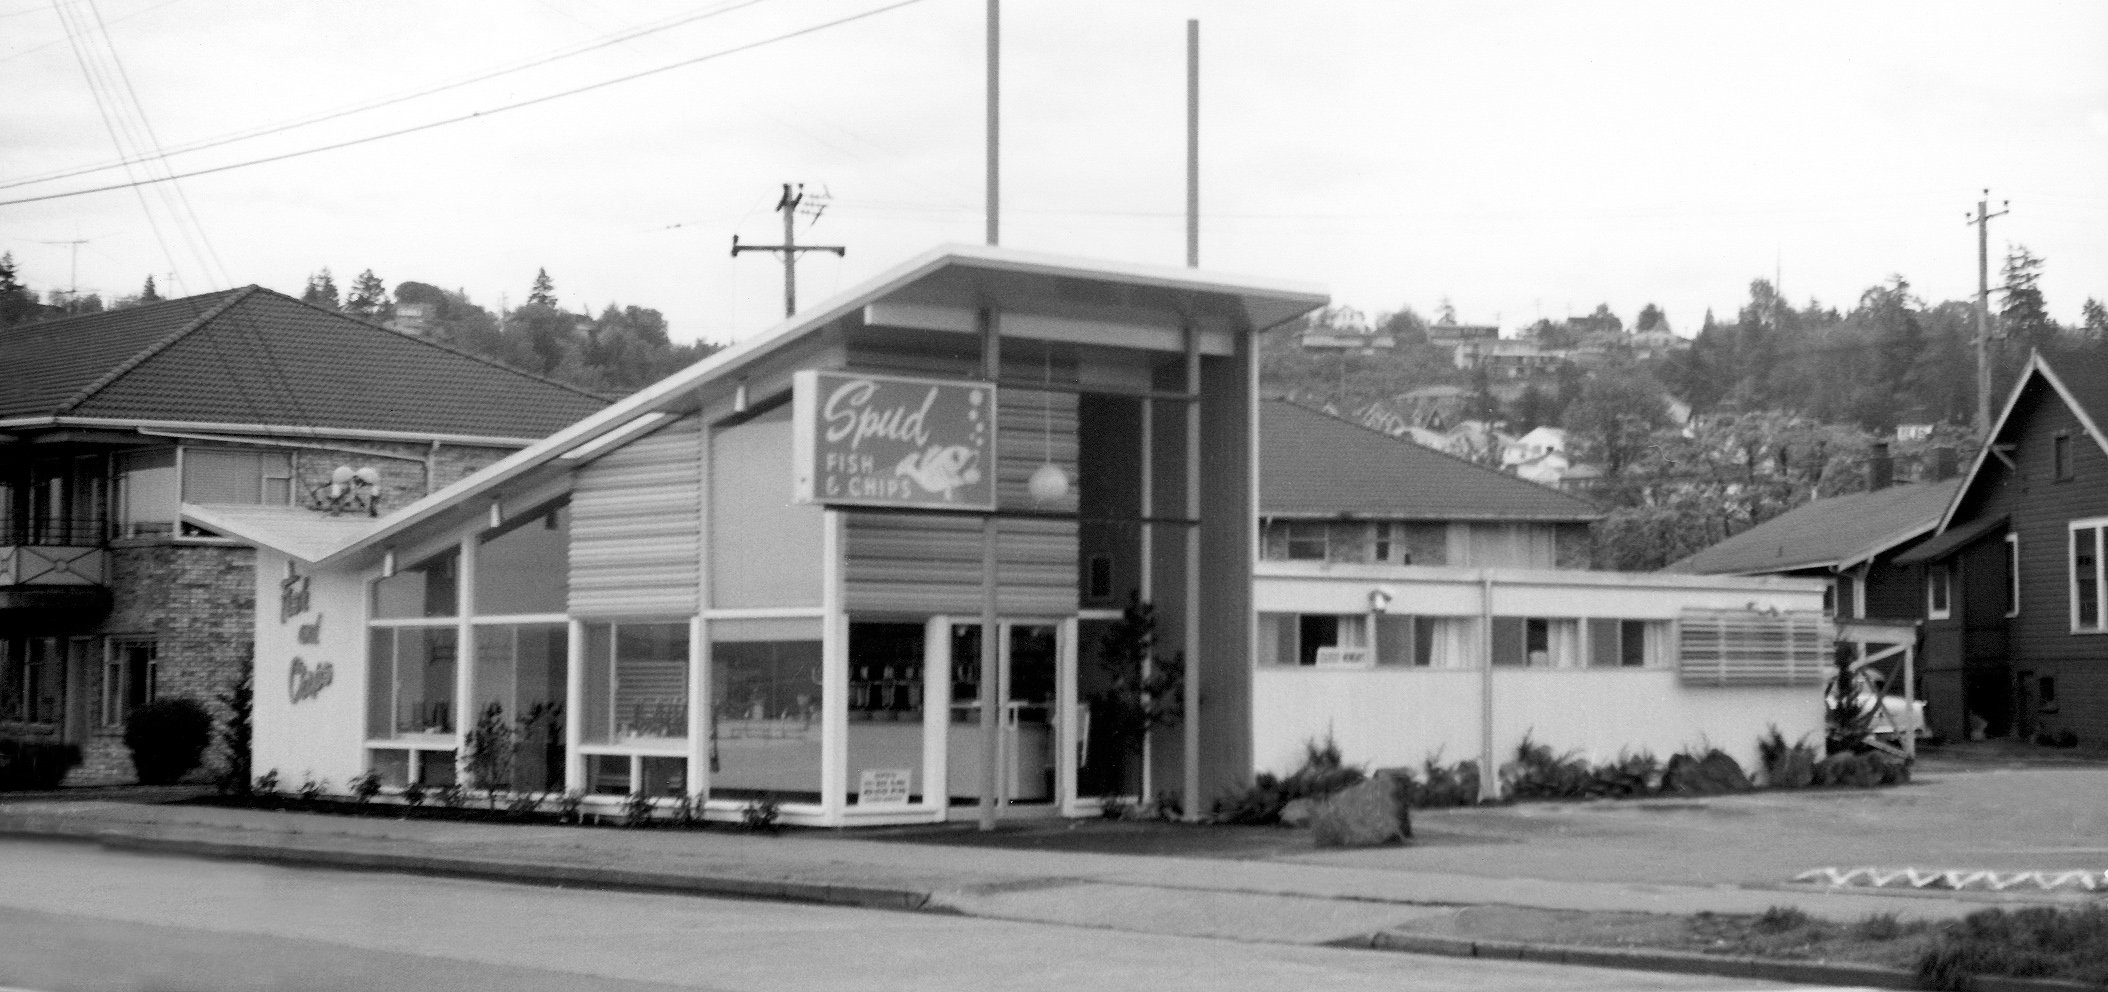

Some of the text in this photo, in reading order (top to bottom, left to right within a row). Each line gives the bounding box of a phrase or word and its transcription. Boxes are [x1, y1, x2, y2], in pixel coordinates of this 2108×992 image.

[823, 379, 939, 450] Spud
[825, 452, 874, 474] FISH
[825, 475, 912, 498] & CHIPS
